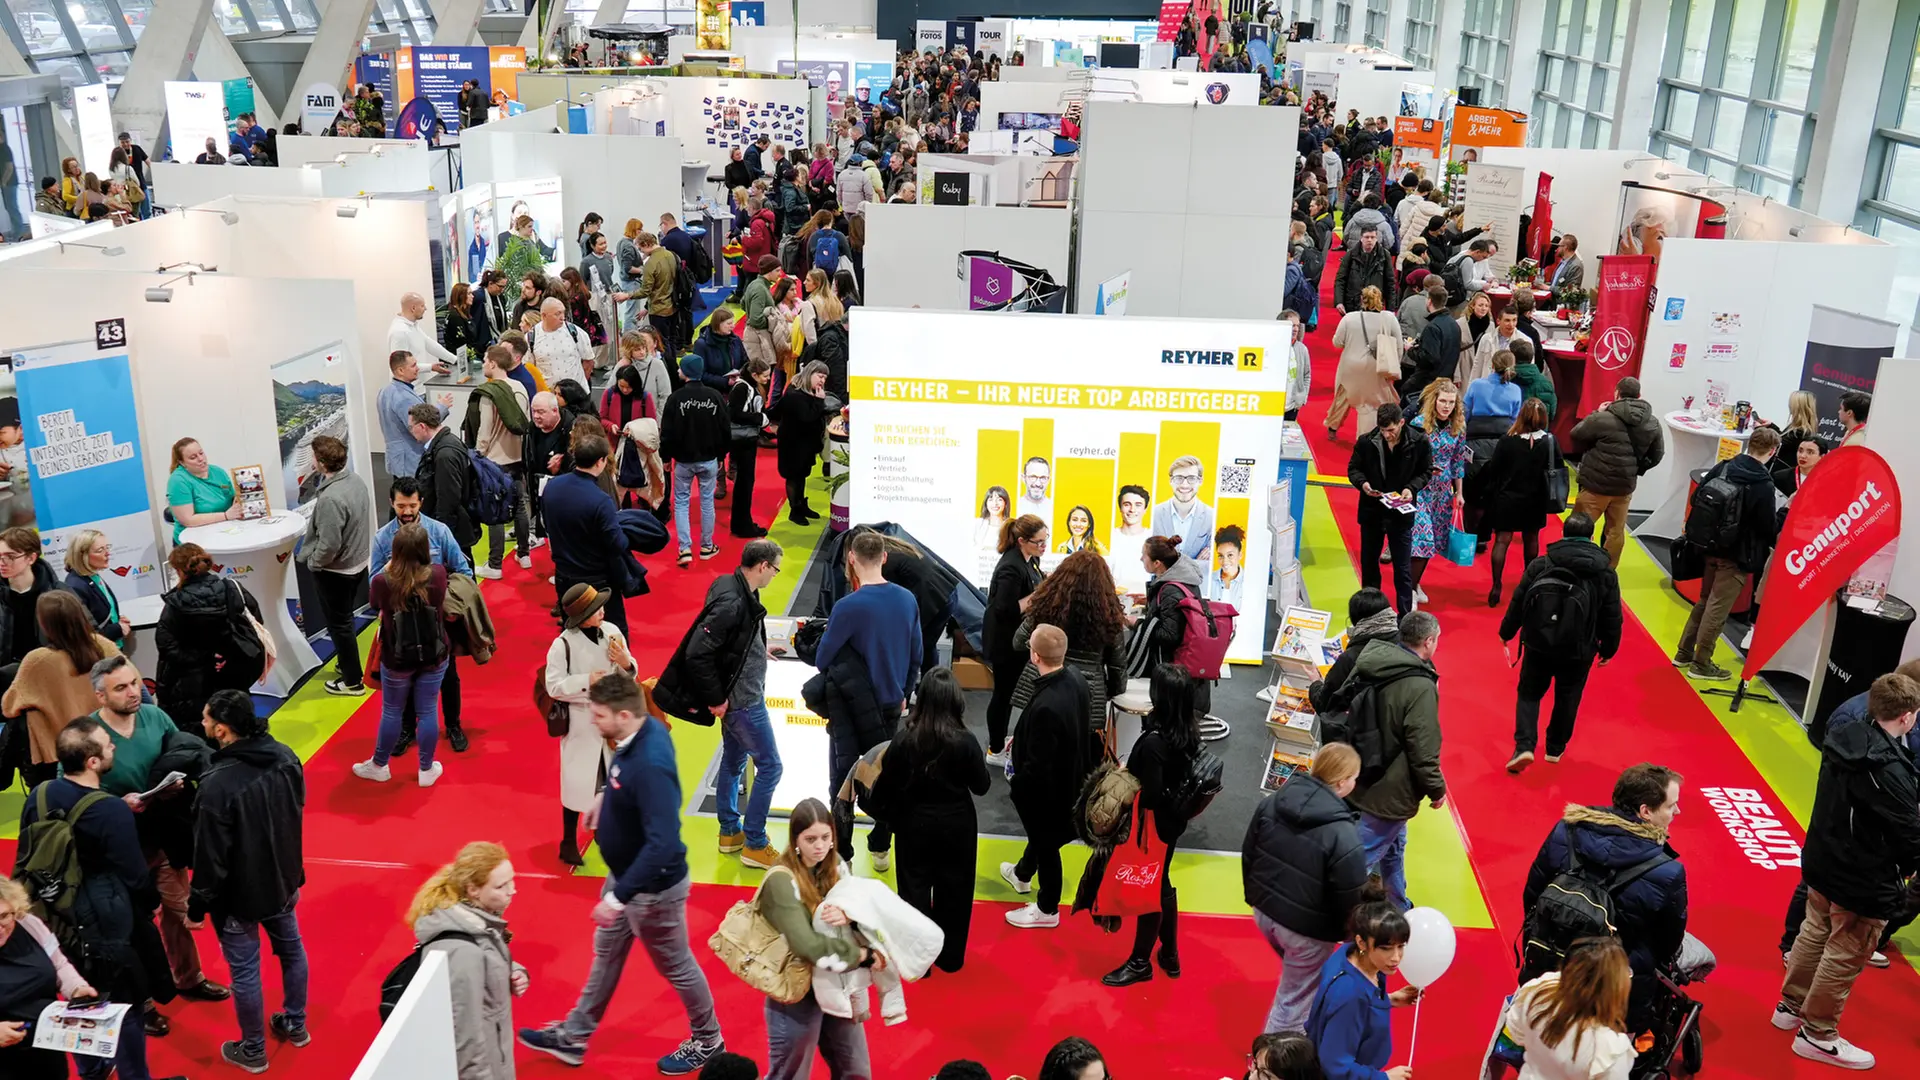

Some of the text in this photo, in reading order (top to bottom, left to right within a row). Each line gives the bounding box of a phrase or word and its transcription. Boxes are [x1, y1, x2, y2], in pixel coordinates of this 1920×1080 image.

[447, 61, 472, 69] STÄRKE
[307, 95, 335, 107] FAM
[1467, 114, 1498, 124] ARBEIT
[942, 183, 962, 202] Ruby
[99, 325, 123, 342] 43
[1161, 350, 1234, 365] REYHER
[873, 380, 949, 400] REYHER
[977, 384, 1011, 403] IHR
[1017, 385, 1081, 405] NEUER
[1086, 388, 1122, 407] TOP
[1128, 391, 1261, 412] ARBEITGEBER
[40, 411, 71, 428] BEREIT
[49, 425, 82, 442] FÜR DIE
[874, 424, 946, 435] WIR SUCHEN SIE
[873, 435, 883, 444] IN
[887, 436, 905, 445] DEN
[33, 433, 108, 462] INTENSIVSTE ZEIT
[1069, 446, 1117, 457] reyher.de
[39, 458, 71, 475] DEINES
[73, 449, 109, 468] LEBENS?
[877, 455, 906, 463] Einkauf
[877, 465, 908, 473] Vertrieb
[877, 475, 935, 486] Instandhaltung
[877, 485, 905, 493] Logistik
[877, 494, 952, 504] Projektmanagement
[1785, 480, 1882, 576] Genuport
[1797, 569, 1816, 590] IMPORT
[1820, 540, 1850, 568] MARKETING
[1854, 502, 1891, 537] DISTRIBUTION
[132, 564, 155, 576] AIDA
[226, 565, 254, 575] AIDA
[1838, 667, 1852, 683] KAY
[1700, 787, 1778, 870] WORKSHOP
[1722, 787, 1802, 868] BEAUTY
